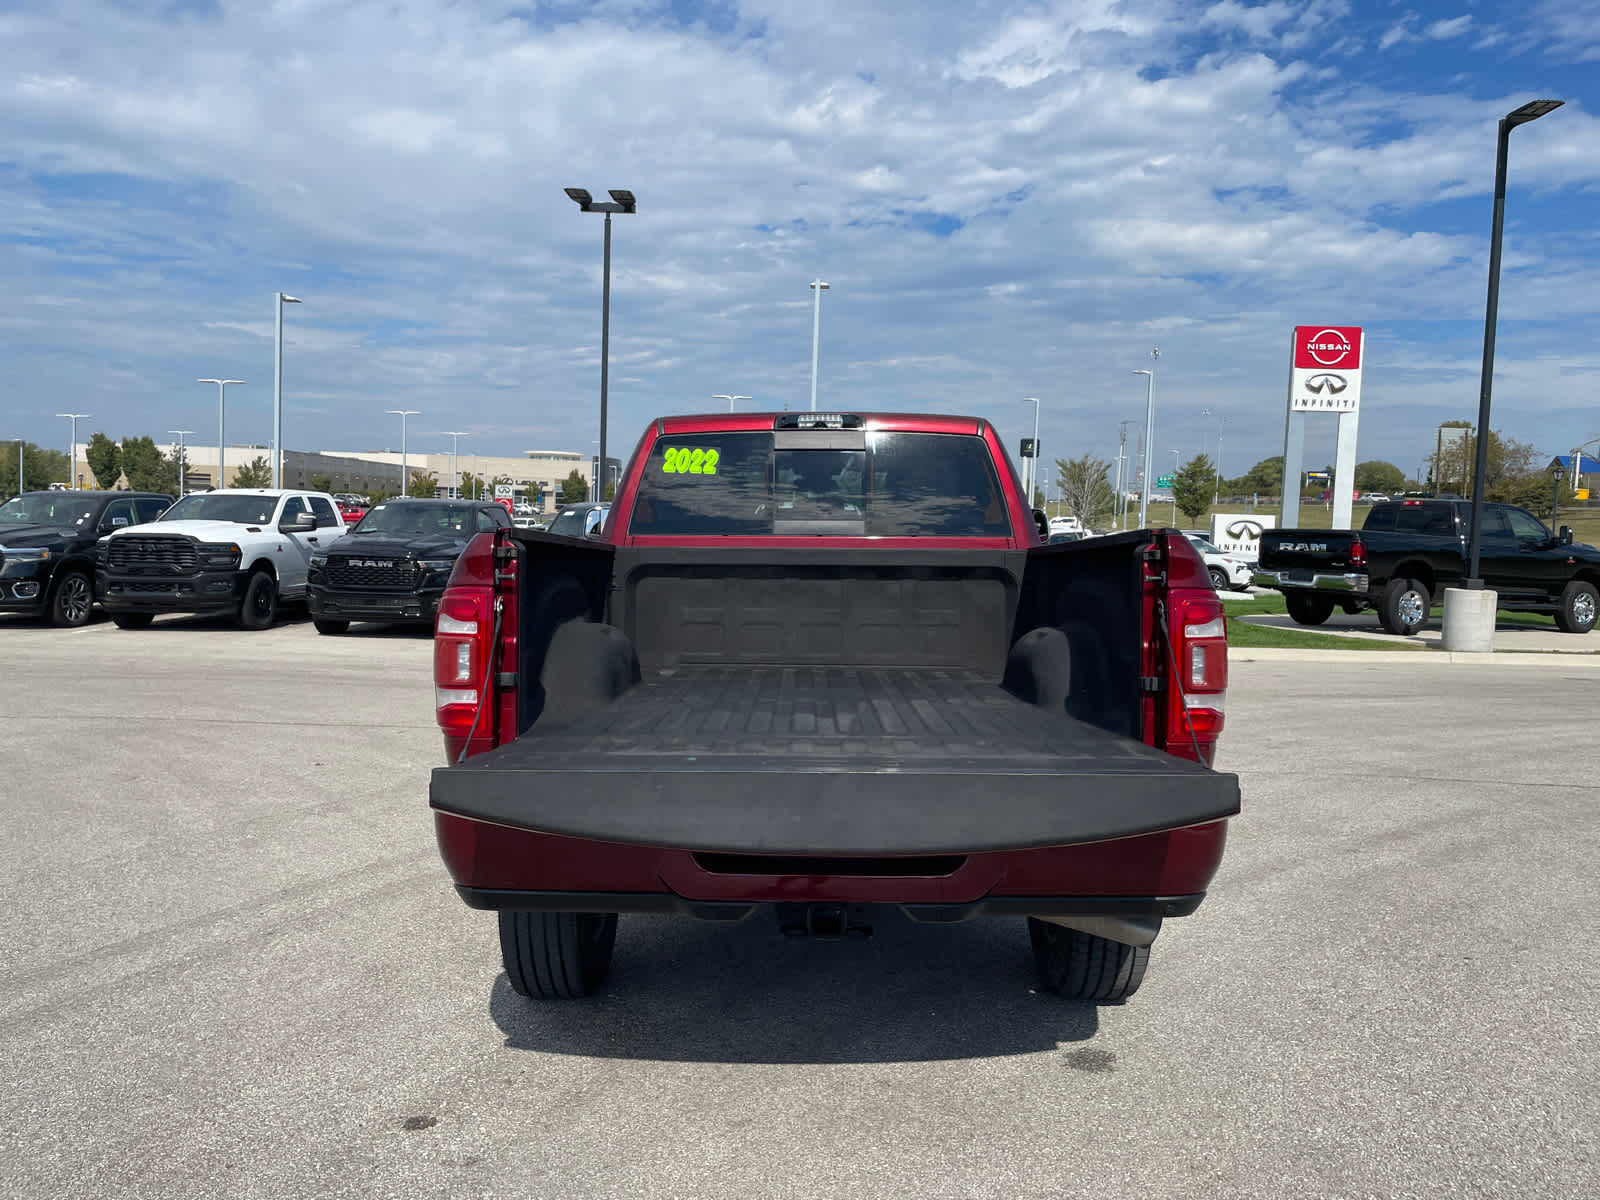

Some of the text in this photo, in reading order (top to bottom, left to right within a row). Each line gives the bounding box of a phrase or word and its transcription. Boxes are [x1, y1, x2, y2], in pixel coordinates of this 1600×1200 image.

[1307, 343, 1351, 351] NISSAN
[1295, 399, 1355, 408] INFINITI
[663, 447, 719, 475] 2022
[1218, 543, 1257, 551] INFINI
[1279, 543, 1327, 551] RAM
[348, 559, 393, 568] RAM
